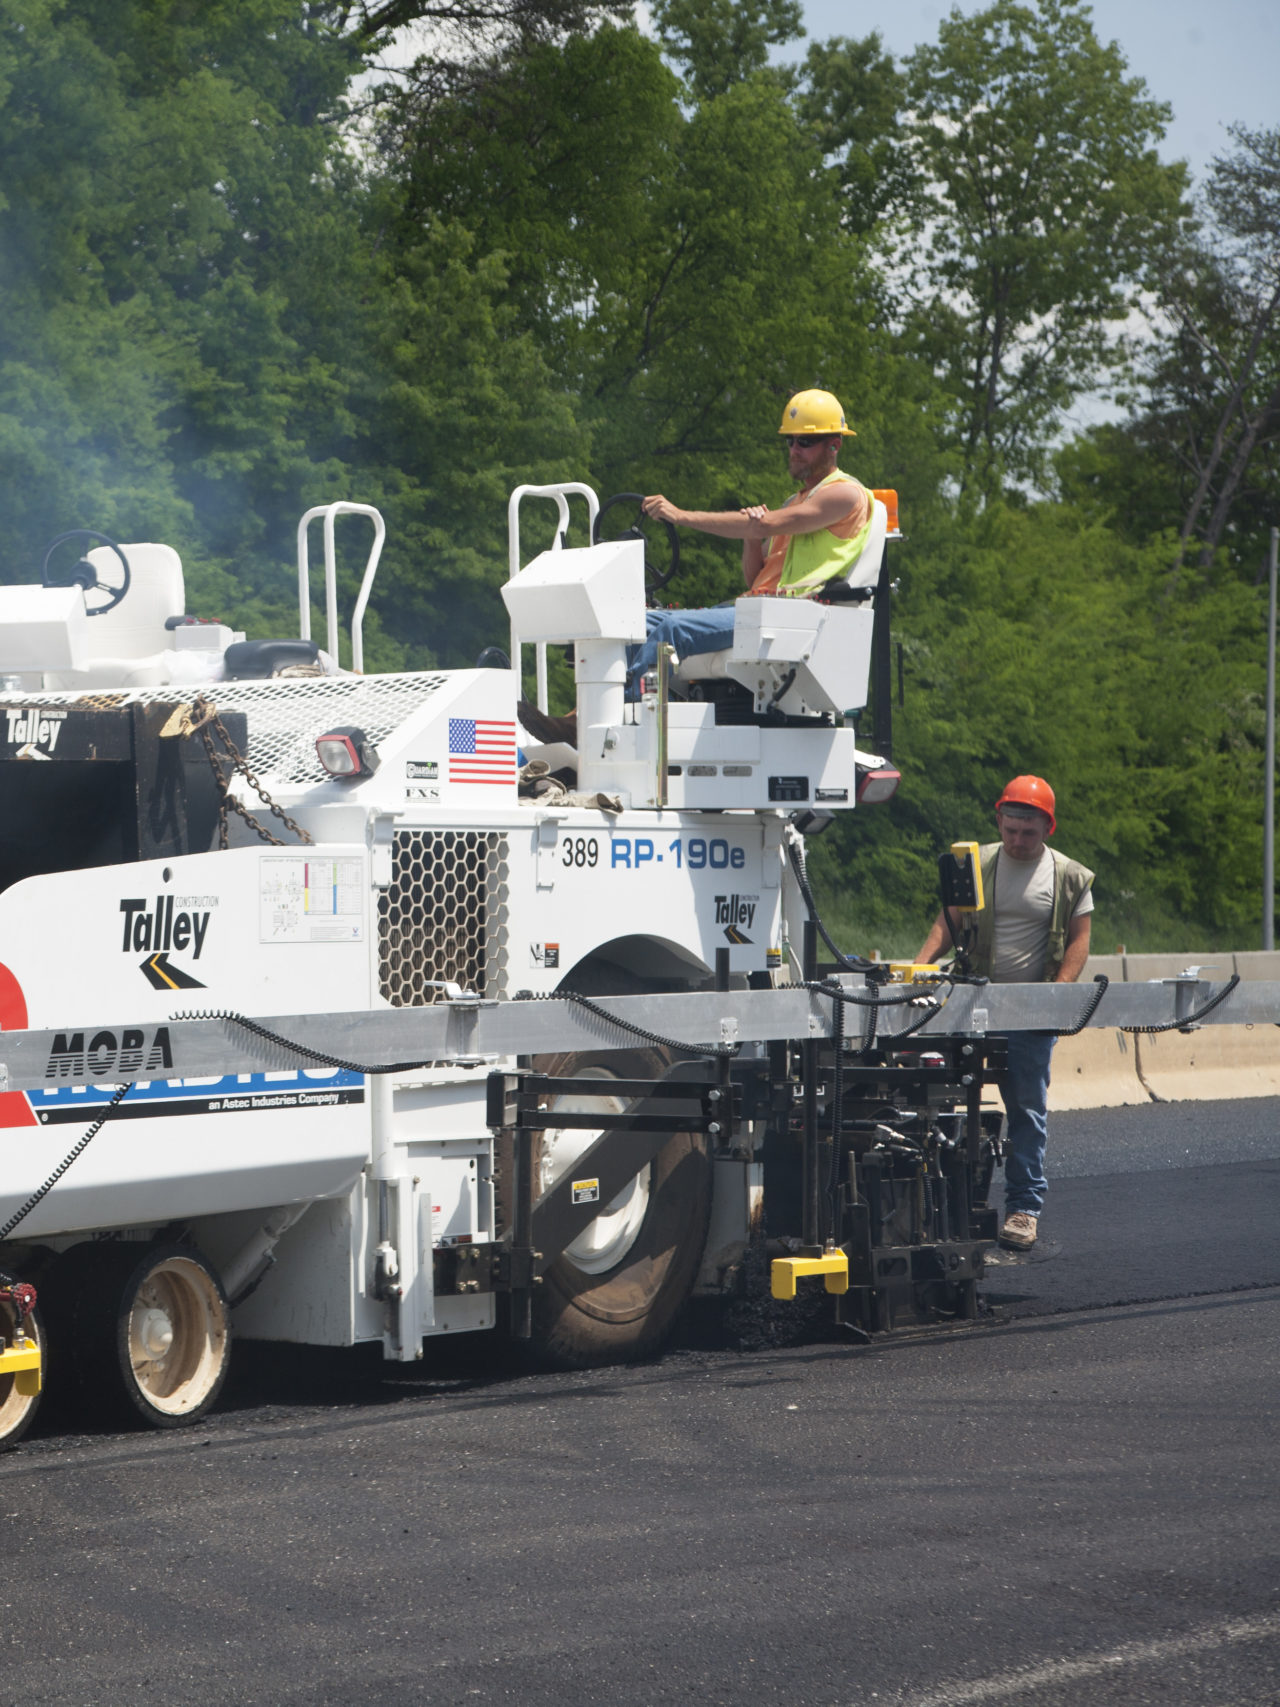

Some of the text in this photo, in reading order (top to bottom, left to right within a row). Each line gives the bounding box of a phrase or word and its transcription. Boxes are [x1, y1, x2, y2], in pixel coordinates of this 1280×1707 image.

[6, 709, 61, 751] Talley
[406, 789, 439, 797] FXS
[562, 837, 745, 869] 389 RP-190e
[175, 896, 219, 907] CONSTRUCTION
[715, 894, 756, 929] Talley
[120, 895, 210, 960] Talley
[45, 1027, 173, 1078] MOBA
[208, 1093, 339, 1110] an Astec Industries Company
